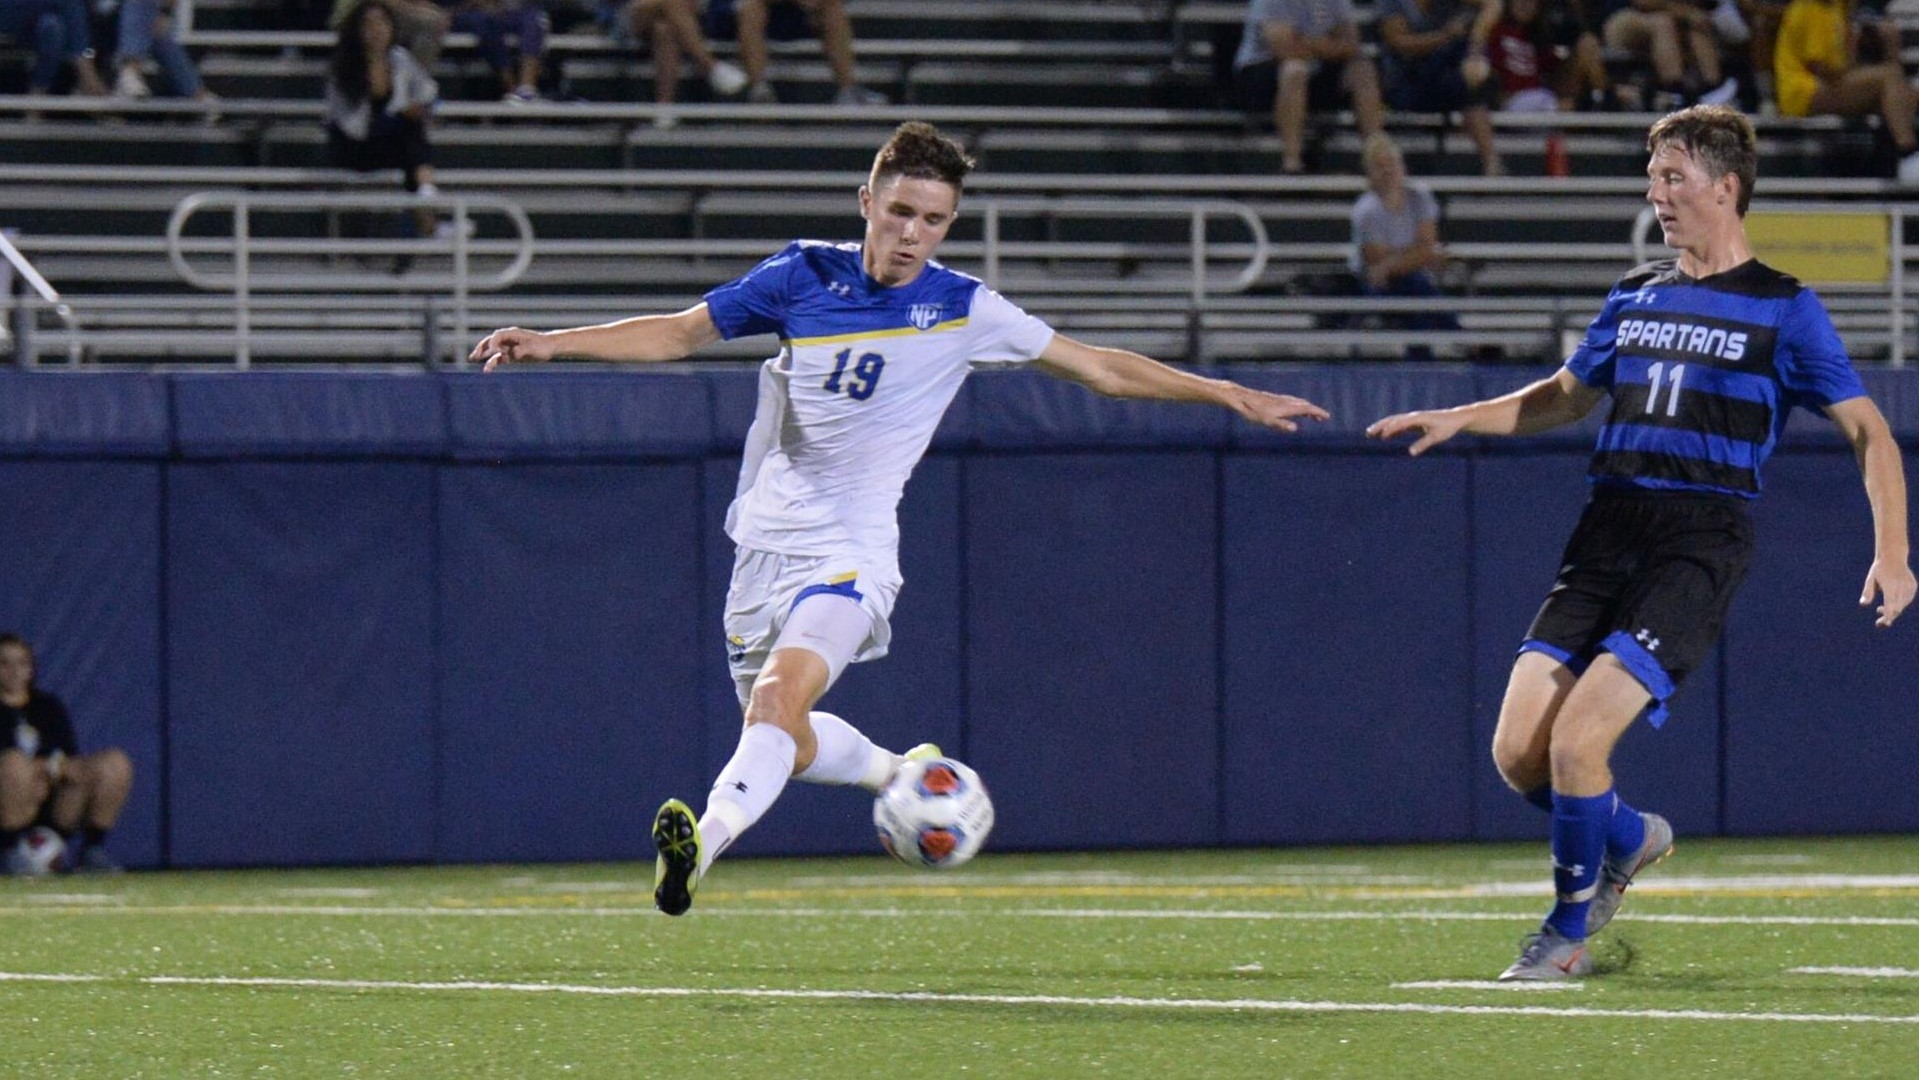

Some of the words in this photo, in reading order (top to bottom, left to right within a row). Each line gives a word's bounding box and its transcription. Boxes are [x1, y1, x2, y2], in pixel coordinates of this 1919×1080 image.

[910, 304, 938, 328] NP
[1616, 320, 1747, 360] SPARTANS
[823, 348, 885, 401] 19
[1645, 362, 1685, 417] 11
